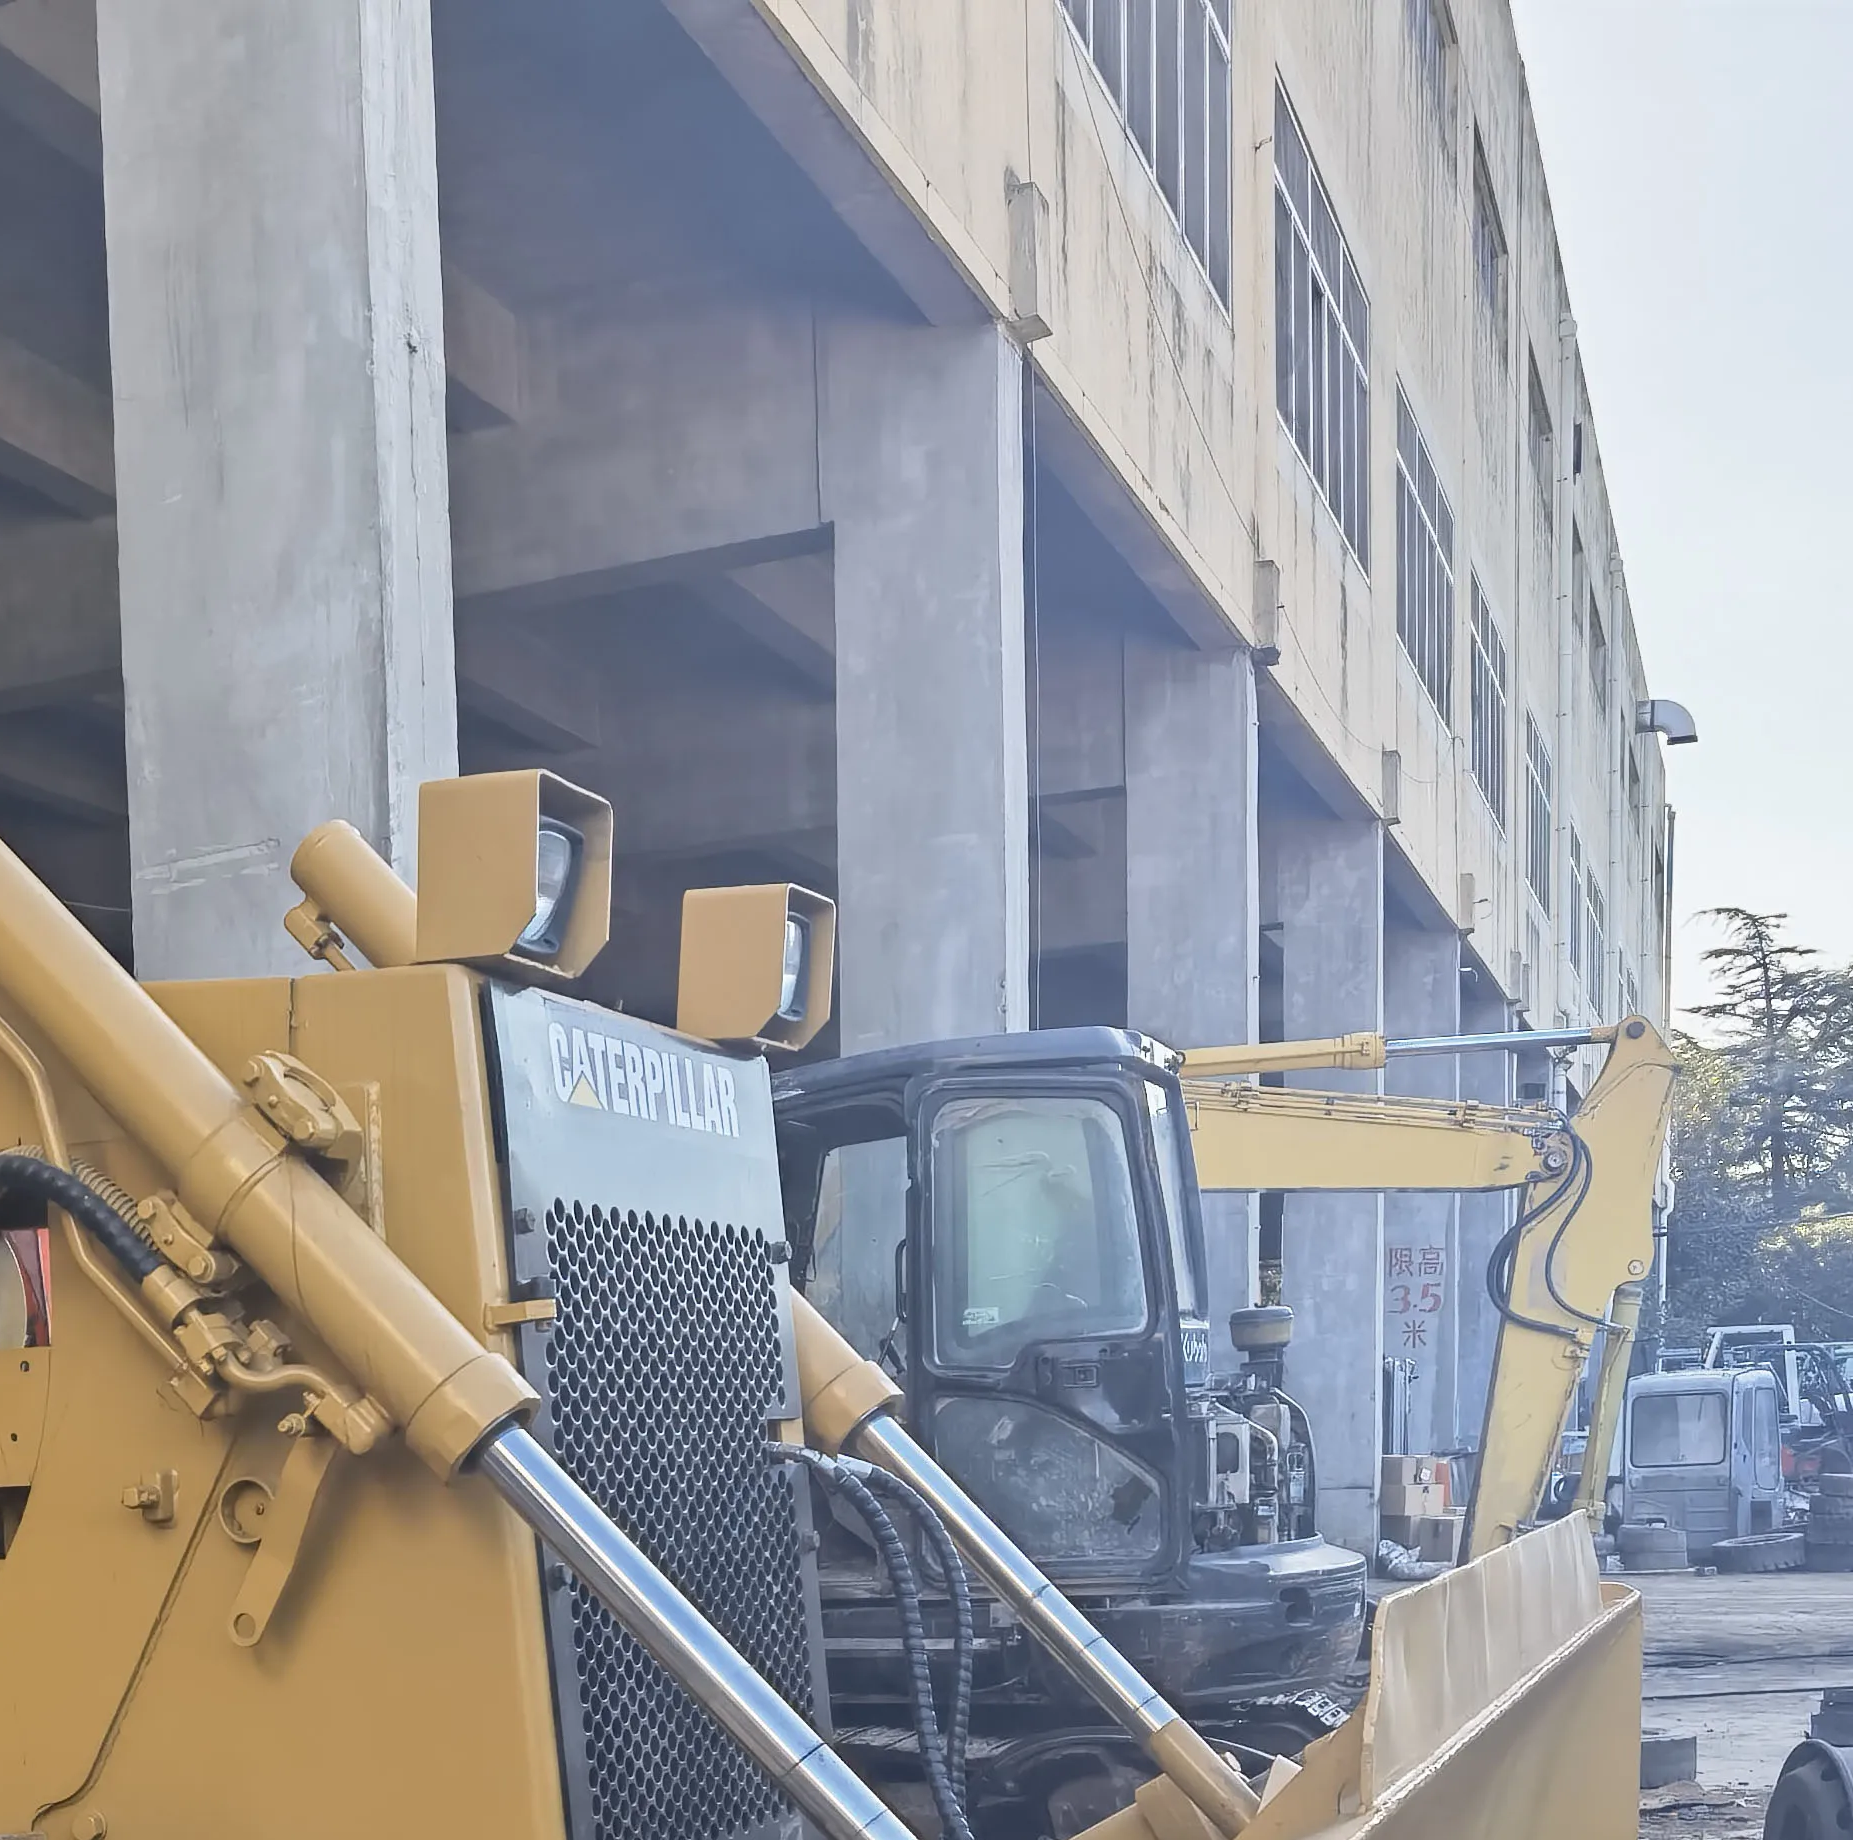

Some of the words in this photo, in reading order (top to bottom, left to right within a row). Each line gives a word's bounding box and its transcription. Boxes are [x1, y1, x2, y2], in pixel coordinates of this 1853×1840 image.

[548, 1021, 740, 1138] CATERPILLAR
[1388, 1245, 1445, 1278] 限高
[1387, 1282, 1443, 1314] 3.5
[1401, 1319, 1427, 1349] 米
